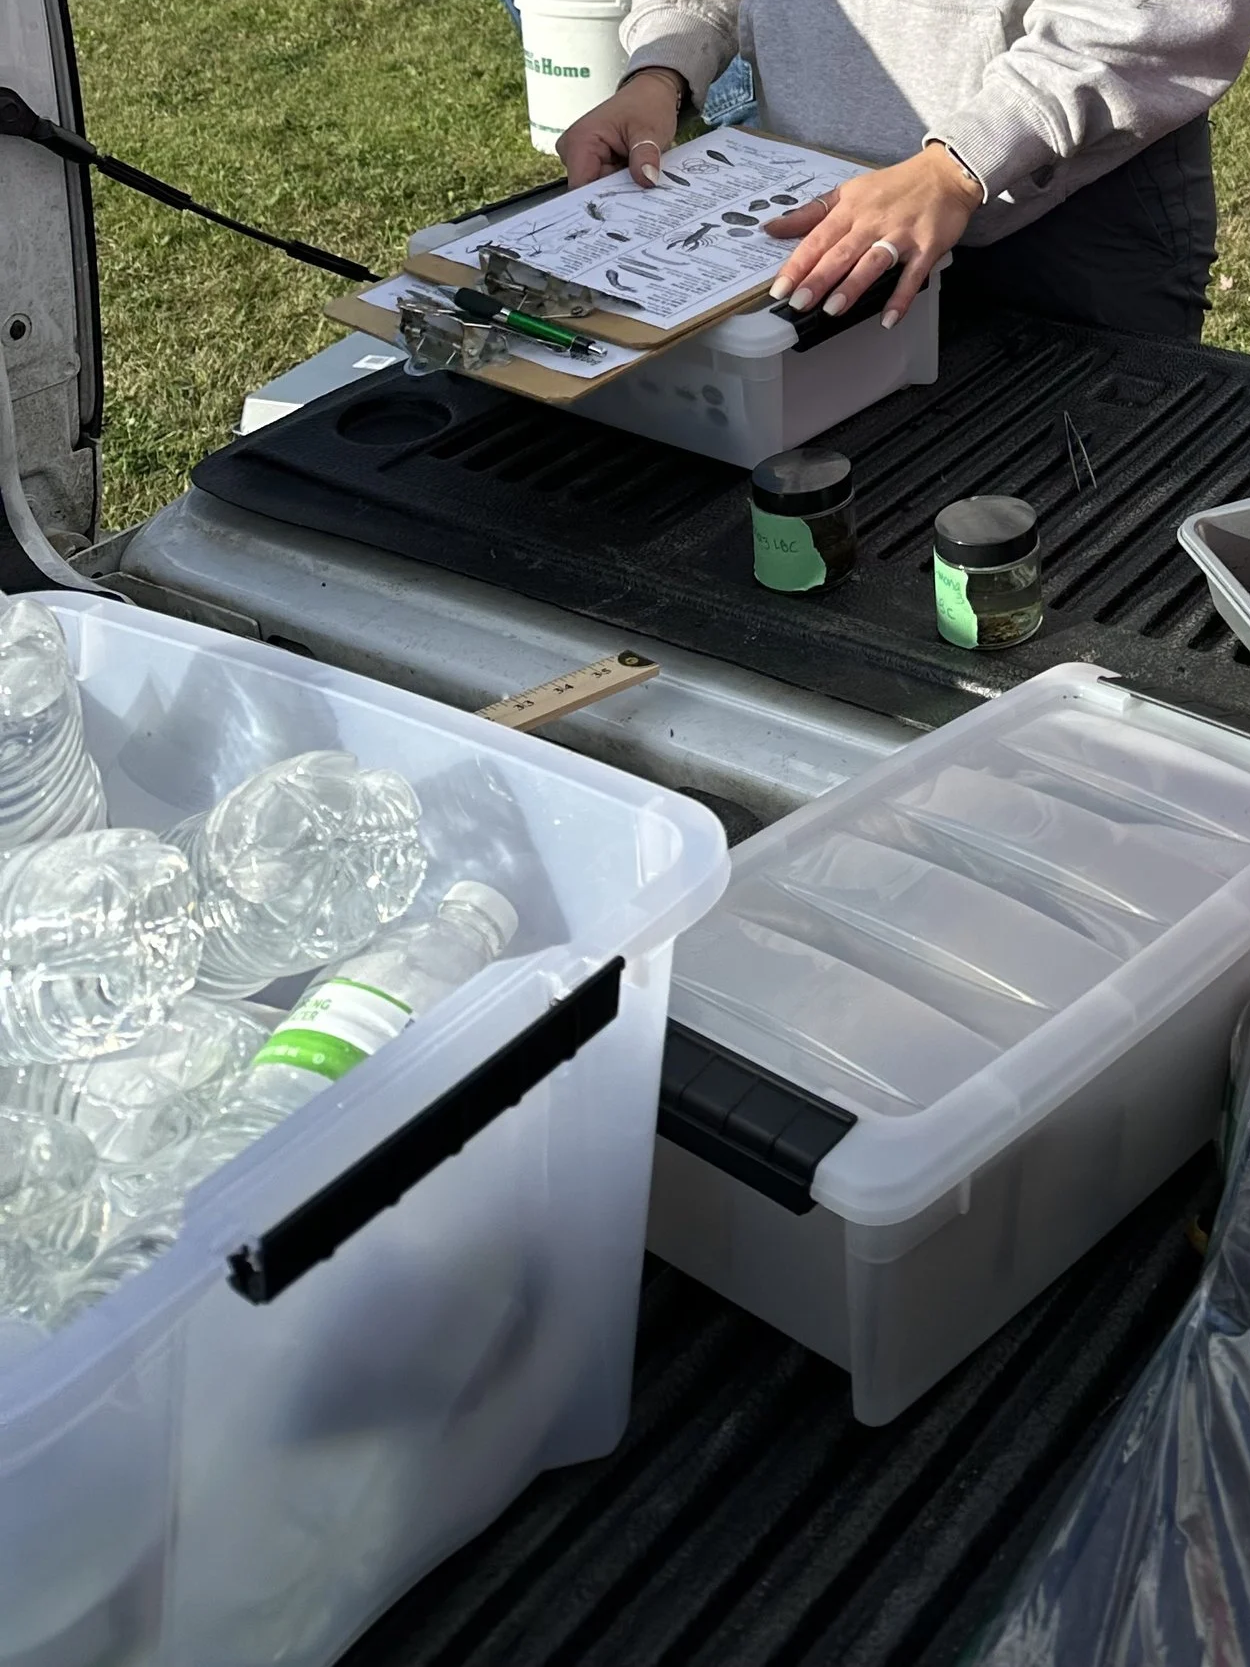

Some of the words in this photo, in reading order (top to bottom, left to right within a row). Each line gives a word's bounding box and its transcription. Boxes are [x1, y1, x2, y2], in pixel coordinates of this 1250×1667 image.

[541, 57, 590, 78] Home
[512, 700, 535, 711] 33
[553, 683, 575, 695] 34
[591, 667, 612, 679] 35
